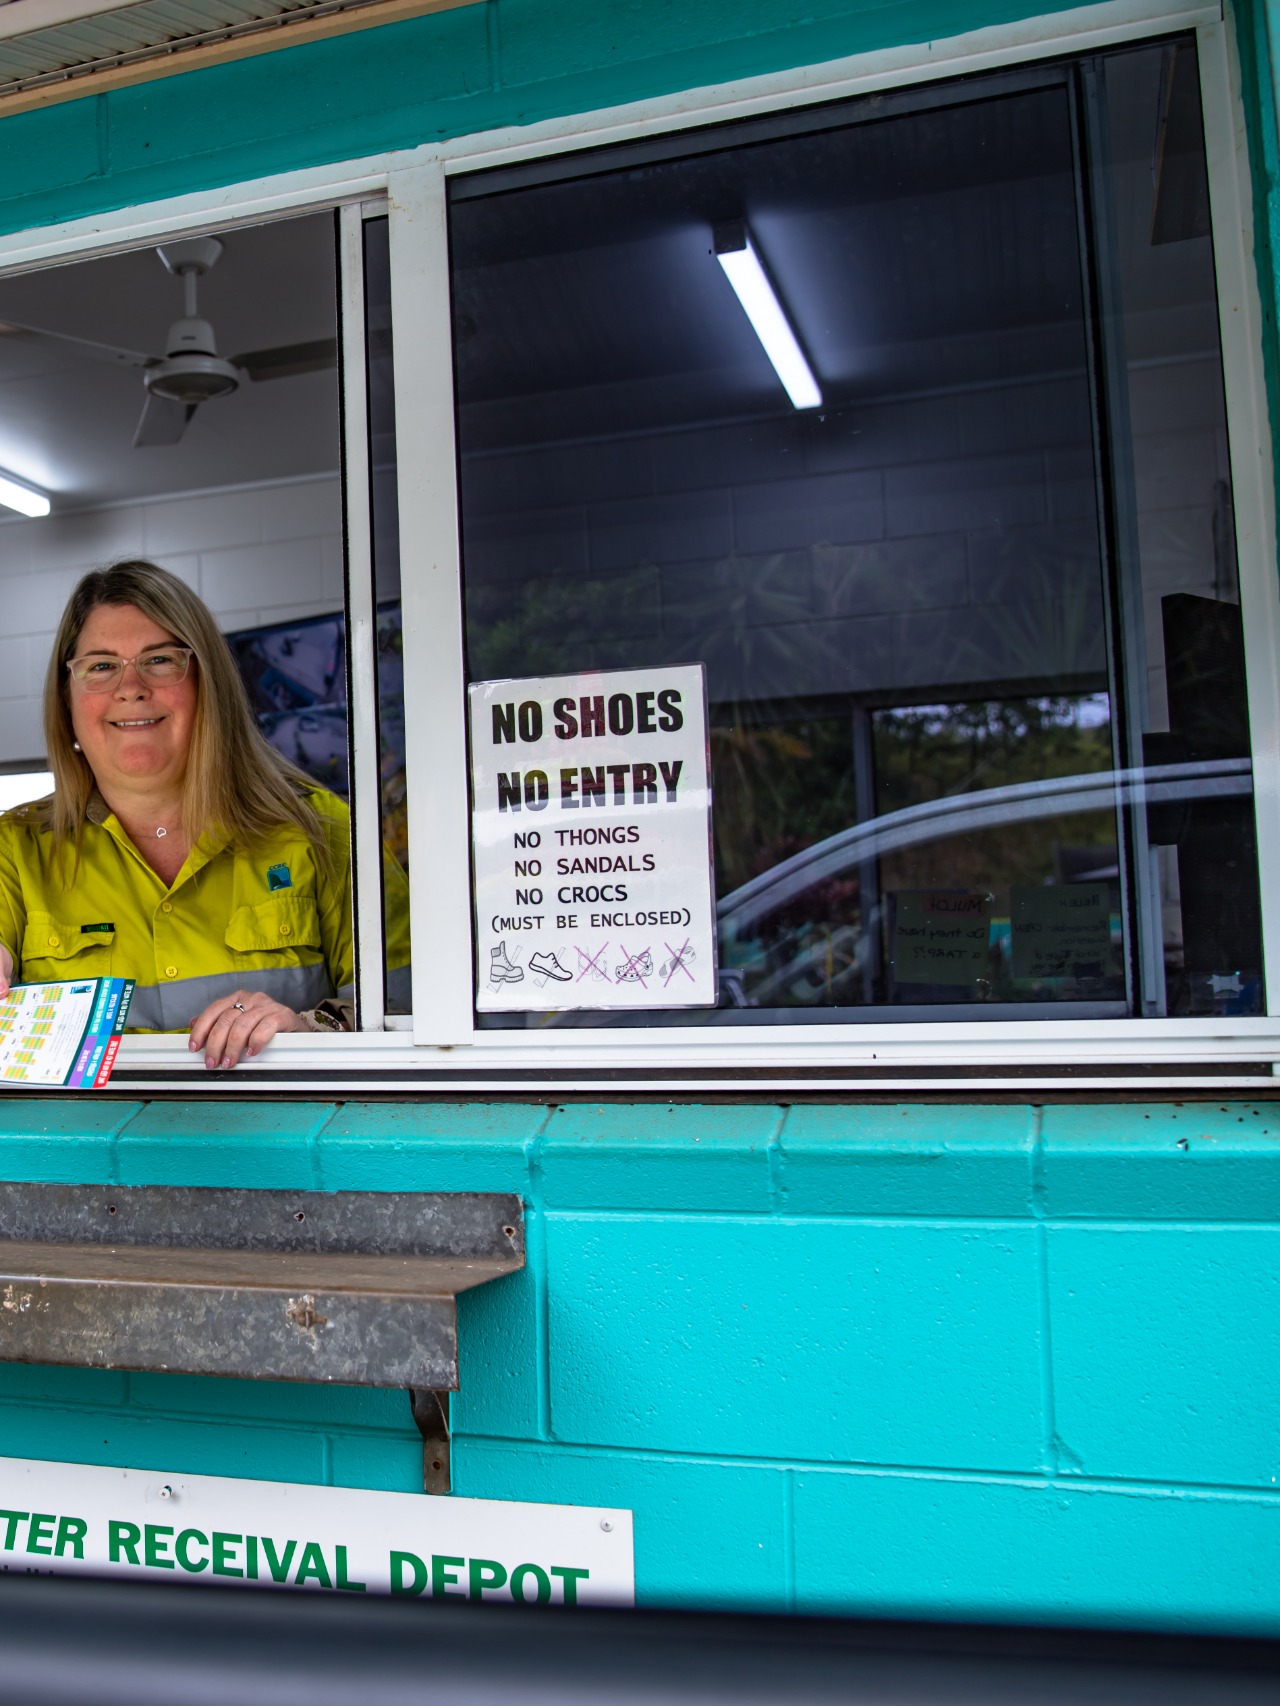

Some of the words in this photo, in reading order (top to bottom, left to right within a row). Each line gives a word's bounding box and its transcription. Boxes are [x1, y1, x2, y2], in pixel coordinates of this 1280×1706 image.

[491, 700, 543, 745] NO
[553, 689, 684, 740] SHOES
[497, 769, 549, 813] NO
[560, 760, 684, 810] ENTRY
[514, 831, 541, 849] NO
[555, 825, 640, 847] THONGS
[514, 860, 542, 877] NO
[557, 854, 656, 875] SANDALS
[515, 888, 543, 906] NO
[557, 884, 628, 903] CROCS
[491, 915, 545, 933] (MUST
[556, 915, 578, 929] BE
[590, 908, 691, 928] ENCLOSED)
[107, 1519, 367, 1593] RECEIVAL
[389, 1550, 590, 1606] DEPOT
